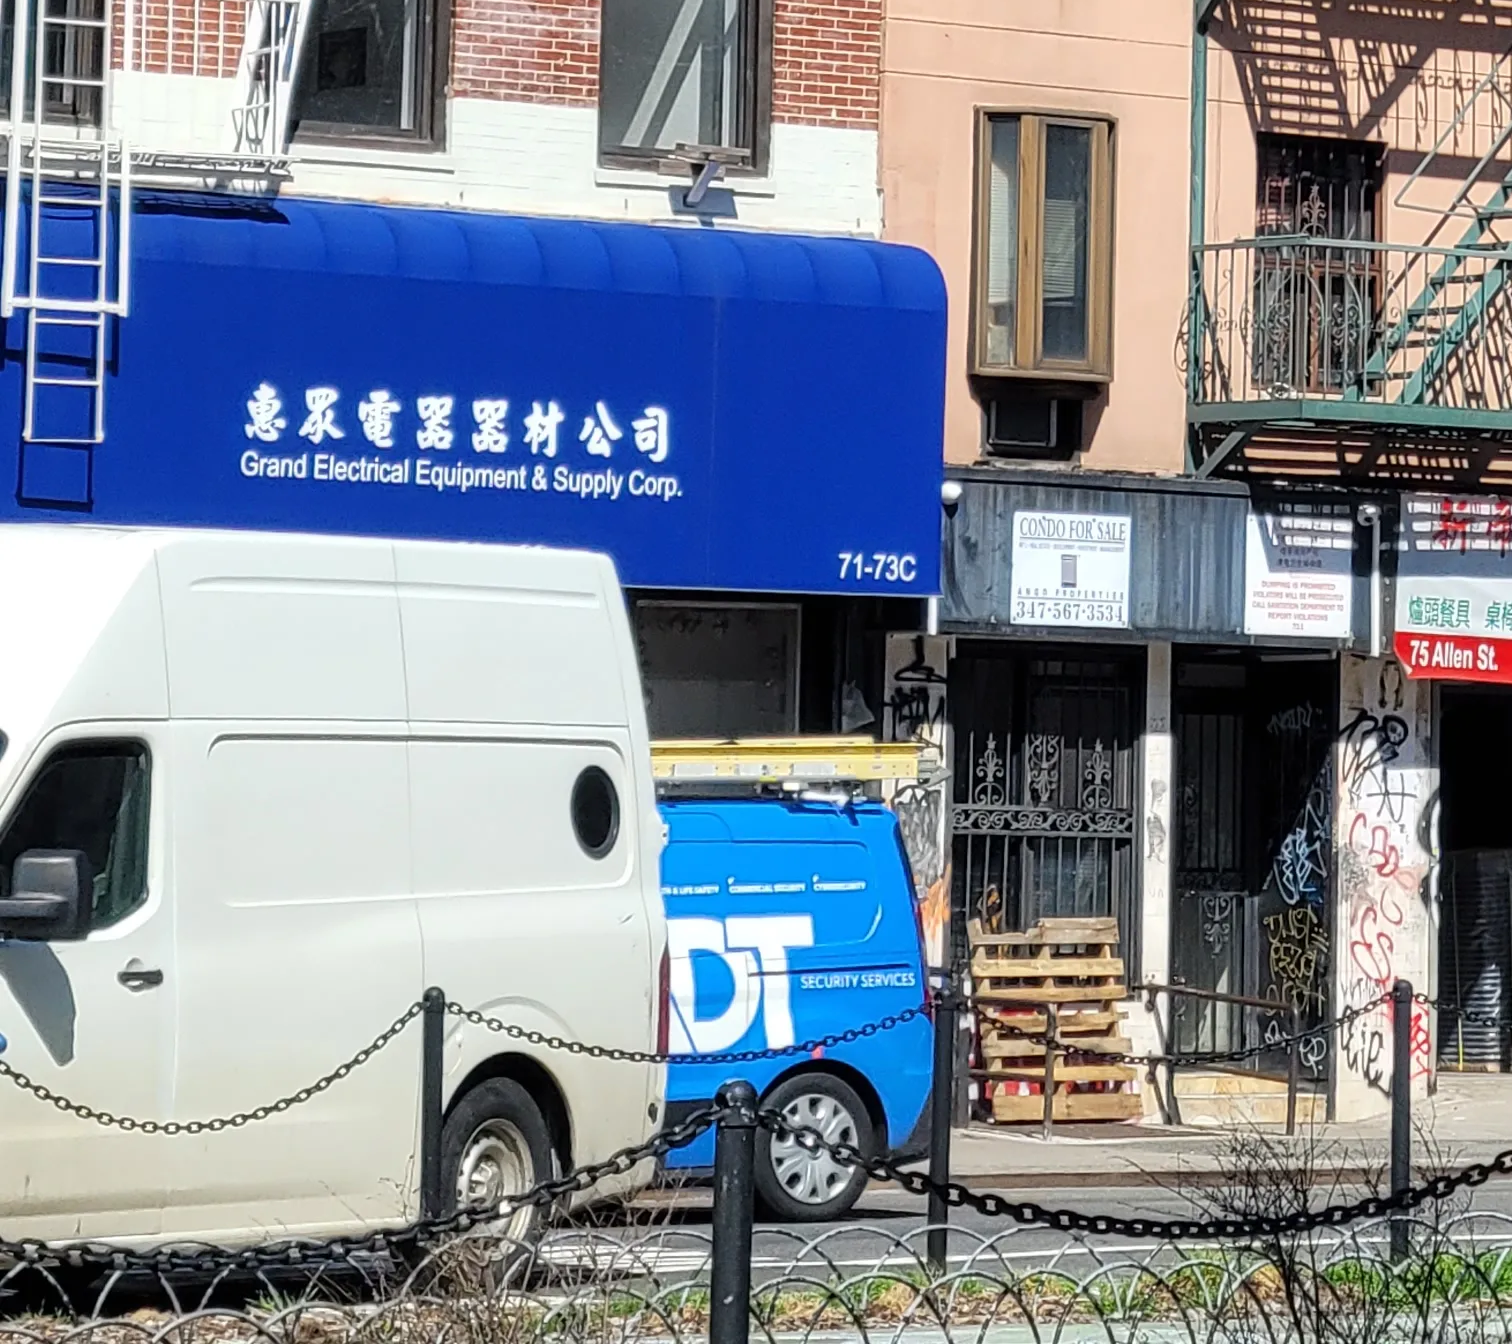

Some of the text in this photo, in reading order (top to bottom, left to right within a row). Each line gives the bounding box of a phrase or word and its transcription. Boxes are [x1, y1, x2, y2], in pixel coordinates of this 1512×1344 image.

[240, 450, 683, 502] Grand Electrical Equipment & Supply Corp.
[1019, 516, 1127, 541] CONDO FOR SALE
[838, 553, 917, 582] 71-73C
[1055, 589, 1124, 601] PROPERTIES
[1285, 592, 1298, 600] WILL
[1299, 592, 1306, 600] BE
[1252, 601, 1266, 609] CALL
[1337, 604, 1344, 612] TO
[1268, 612, 1328, 621] REPORT VIOLATIONS
[1410, 640, 1499, 671] 75 Allen St.
[668, 913, 815, 1054] DT
[801, 972, 916, 990] SECURITY SERVICES
